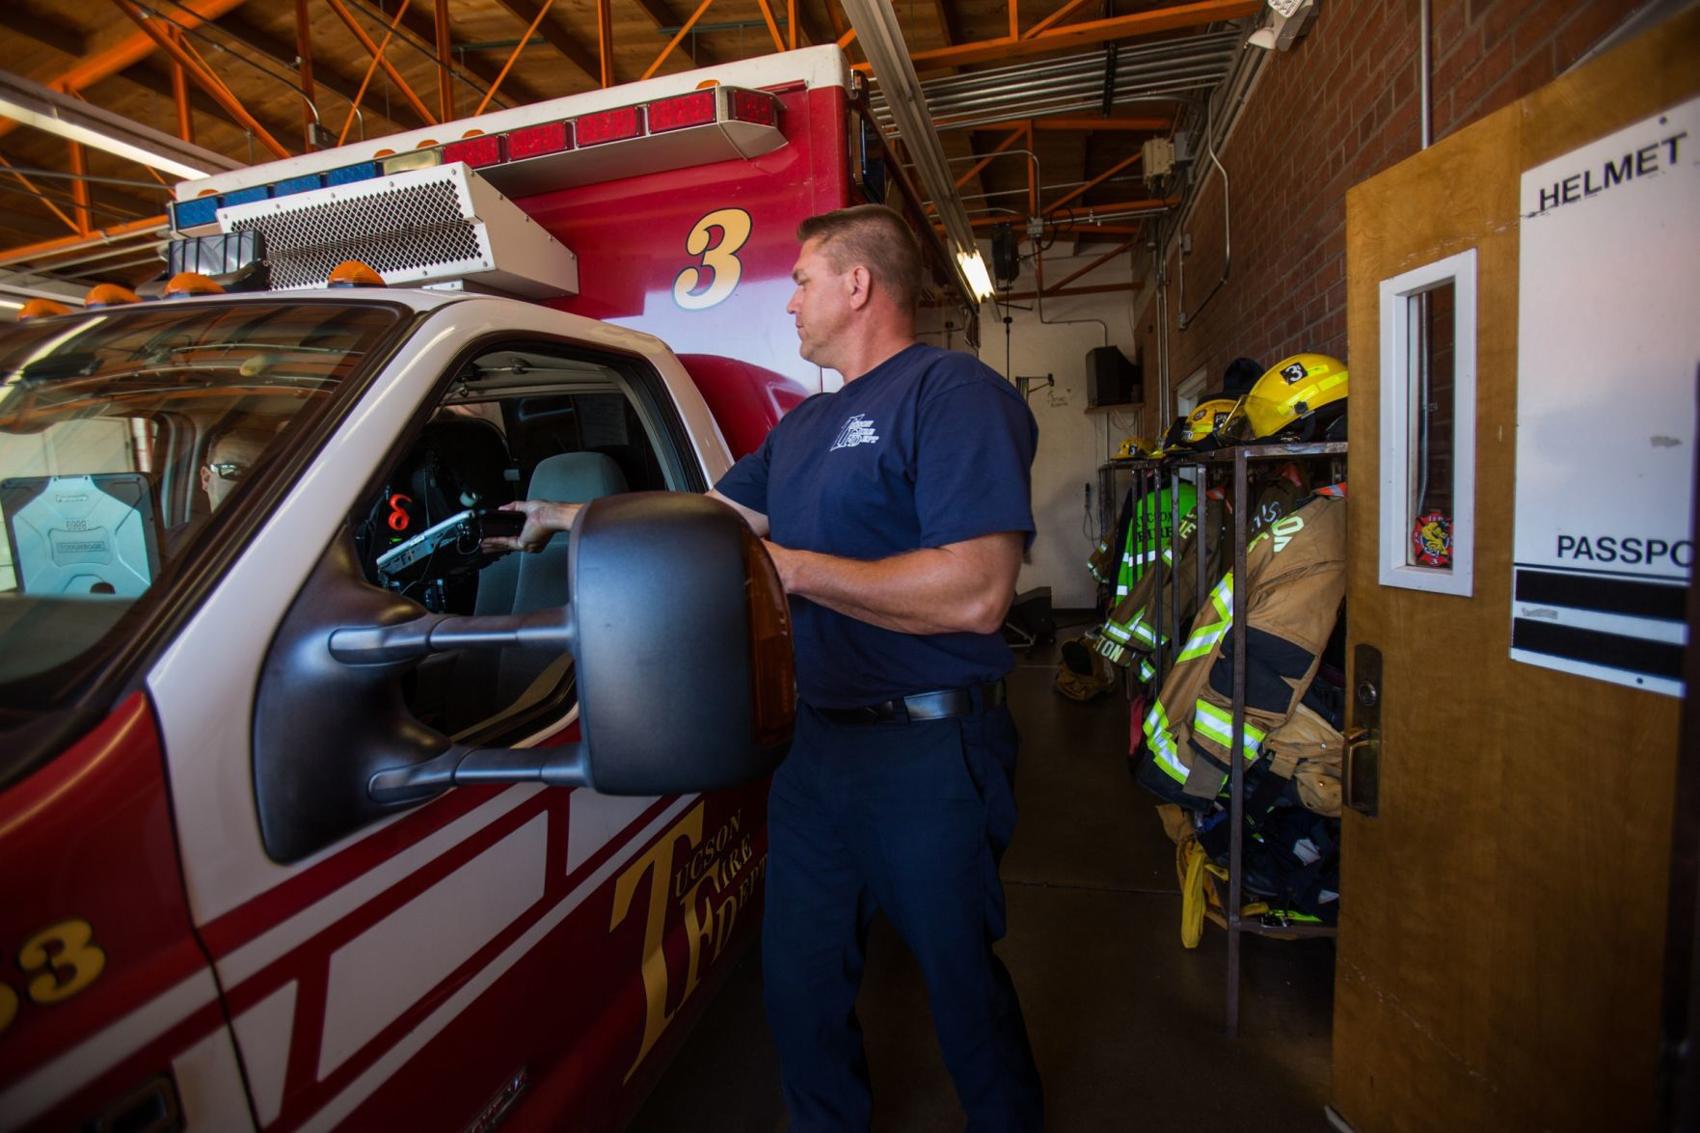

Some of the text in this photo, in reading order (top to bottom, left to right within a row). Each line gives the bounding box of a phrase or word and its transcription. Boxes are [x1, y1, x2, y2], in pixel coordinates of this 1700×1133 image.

[1539, 131, 1688, 212] HELMET
[672, 207, 752, 311] 3
[1285, 364, 1303, 382] 3
[0, 916, 107, 1033] 3
[609, 800, 743, 1087] TUCSON
[669, 833, 753, 1014] FIRE
